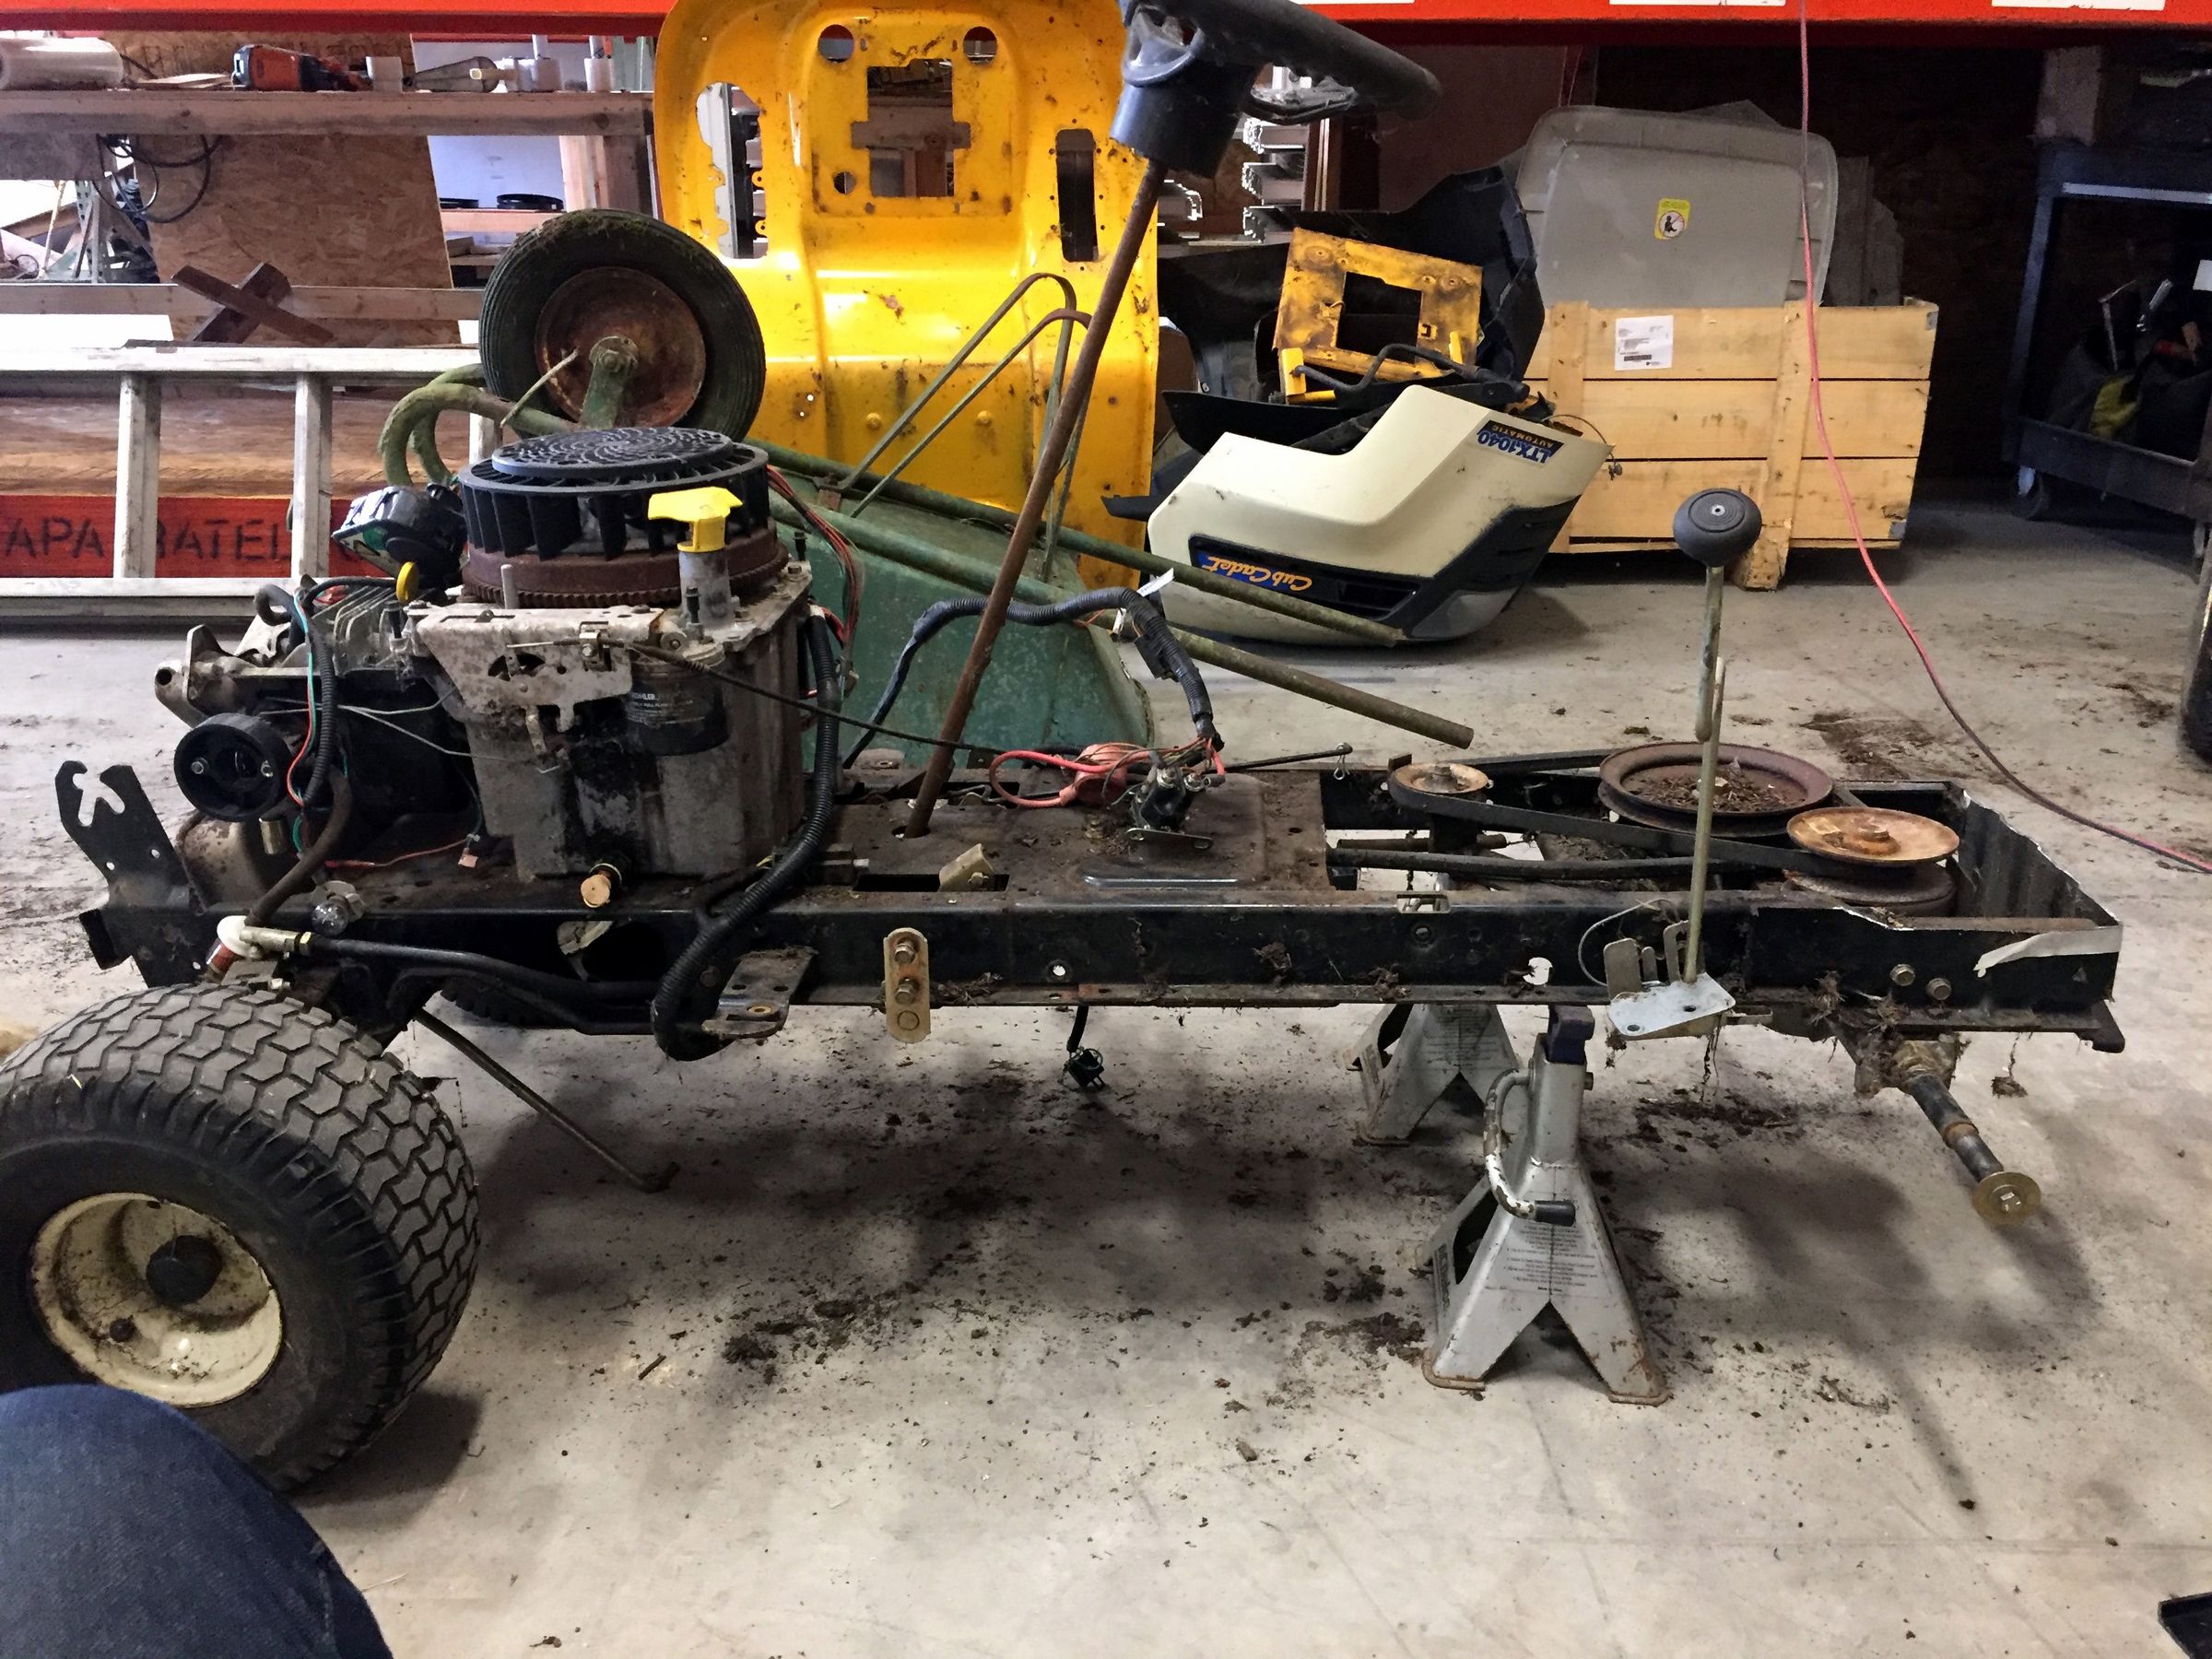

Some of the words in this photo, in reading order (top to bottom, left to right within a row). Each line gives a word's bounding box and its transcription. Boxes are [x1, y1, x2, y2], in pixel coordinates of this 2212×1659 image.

[1491, 425, 1554, 449] AUTOMATIC
[6, 515, 106, 559] APA
[1202, 556, 1271, 582] Cadet
[1272, 571, 1312, 591] Cub
